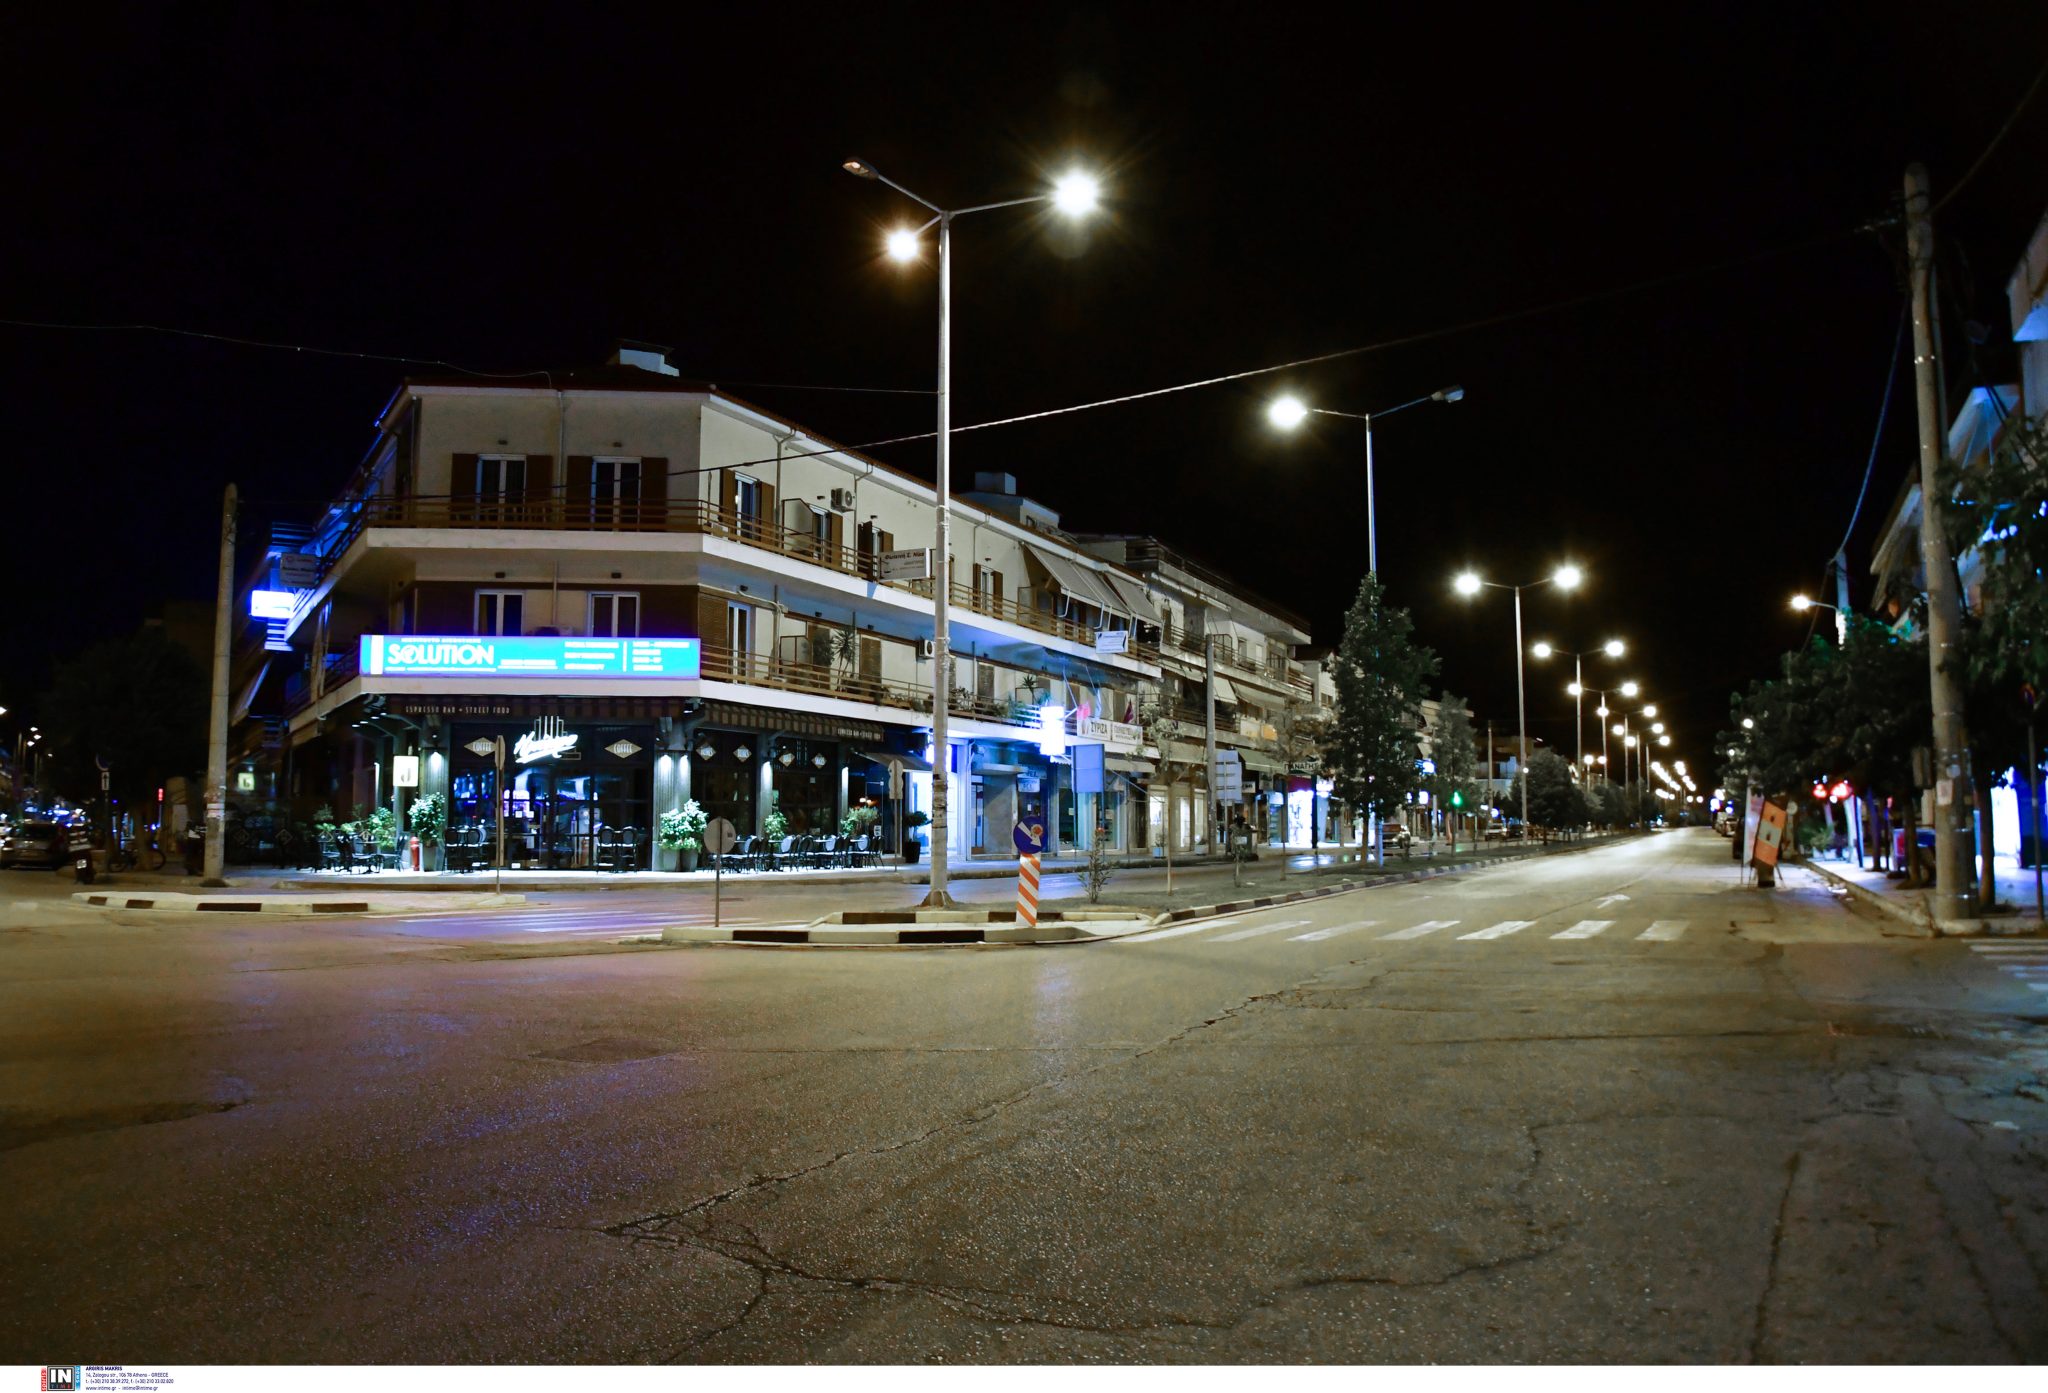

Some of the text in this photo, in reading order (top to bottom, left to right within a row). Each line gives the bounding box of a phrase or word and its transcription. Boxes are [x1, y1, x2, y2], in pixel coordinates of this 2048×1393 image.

[387, 643, 495, 665] SOLUTION
[1090, 721, 1108, 735] ΣΥΡΙΖΑ
[472, 741, 493, 752] COFFEE
[613, 743, 634, 754] COFFEE
